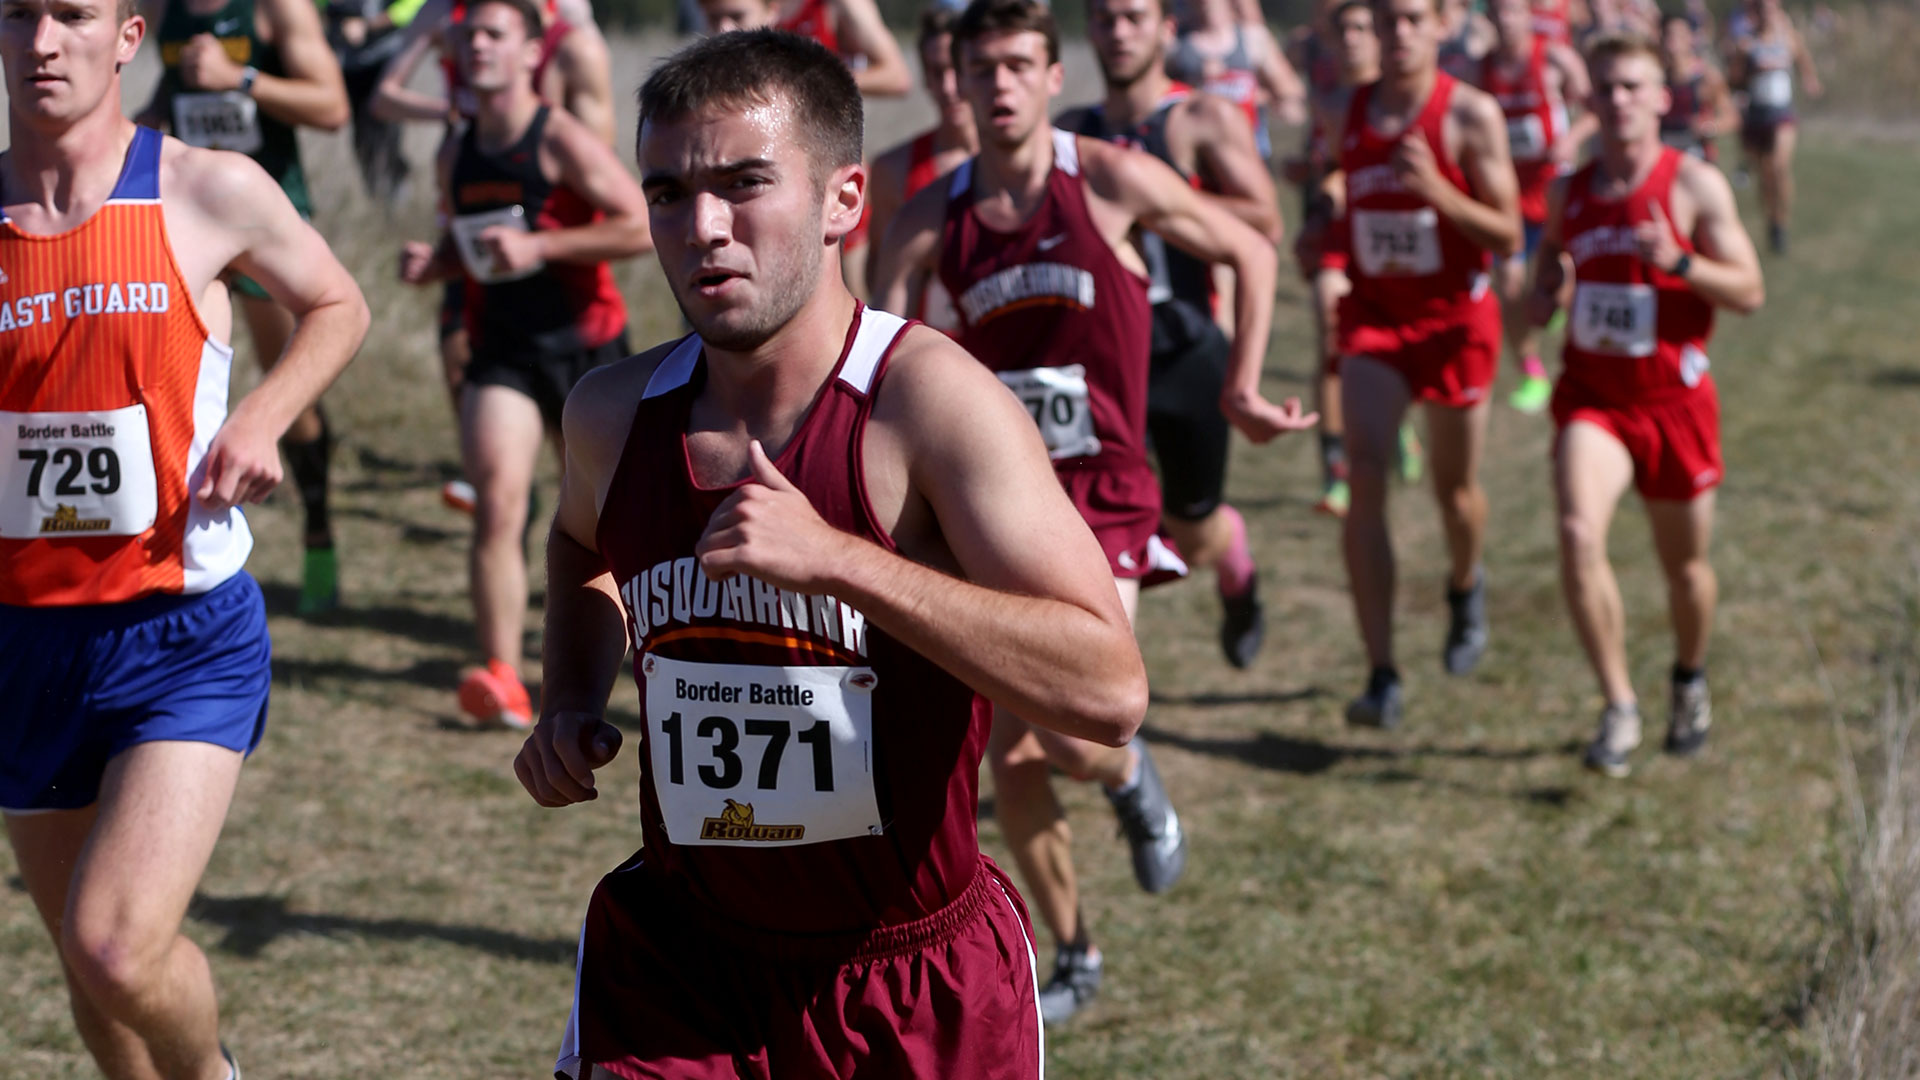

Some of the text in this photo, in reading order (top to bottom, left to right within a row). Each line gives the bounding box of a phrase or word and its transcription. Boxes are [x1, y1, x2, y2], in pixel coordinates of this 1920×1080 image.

[64, 282, 169, 319] GUARD
[18, 423, 115, 438] Border Battle
[18, 447, 121, 497] 729
[676, 678, 814, 706] Border Battle
[662, 712, 834, 792] 1371
[701, 817, 805, 841] Rowan
